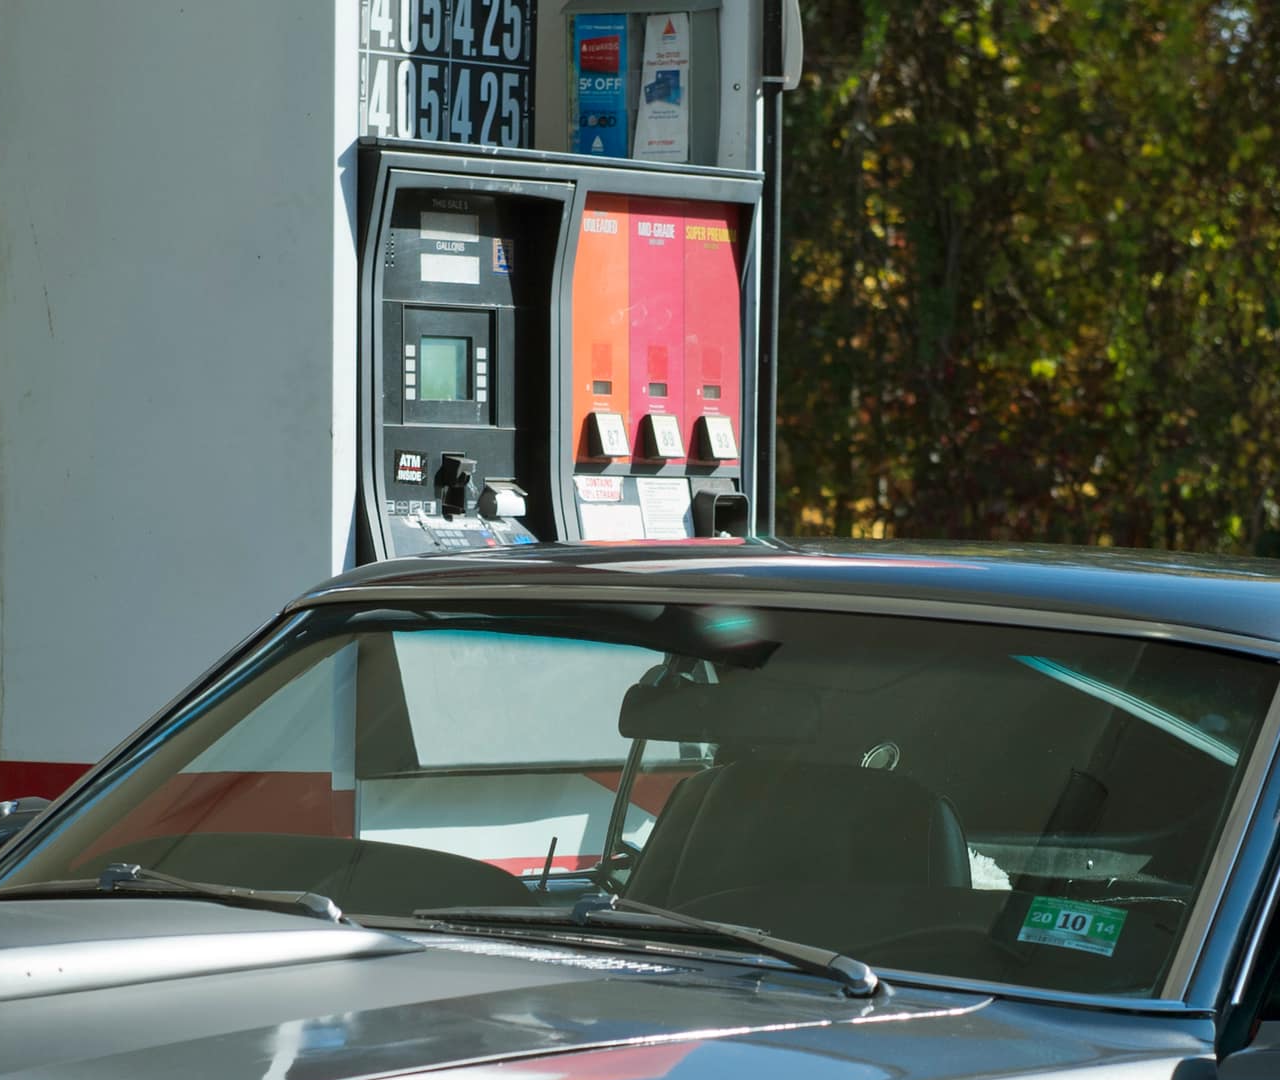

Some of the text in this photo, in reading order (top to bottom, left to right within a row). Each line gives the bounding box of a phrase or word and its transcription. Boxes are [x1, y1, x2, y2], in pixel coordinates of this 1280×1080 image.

[595, 78, 622, 91] OFF
[367, 59, 439, 140] 4.05
[451, 69, 520, 149] 4.25
[584, 218, 618, 234] UNLEADED
[638, 221, 676, 239] MID-GRADE
[686, 225, 706, 241] SUPER
[436, 241, 465, 252] GALLONS
[607, 429, 620, 446] 87
[716, 432, 730, 449] 93
[400, 453, 421, 467] ATM
[397, 470, 422, 481] INSIDE
[1031, 912, 1115, 935] 20 10 14
